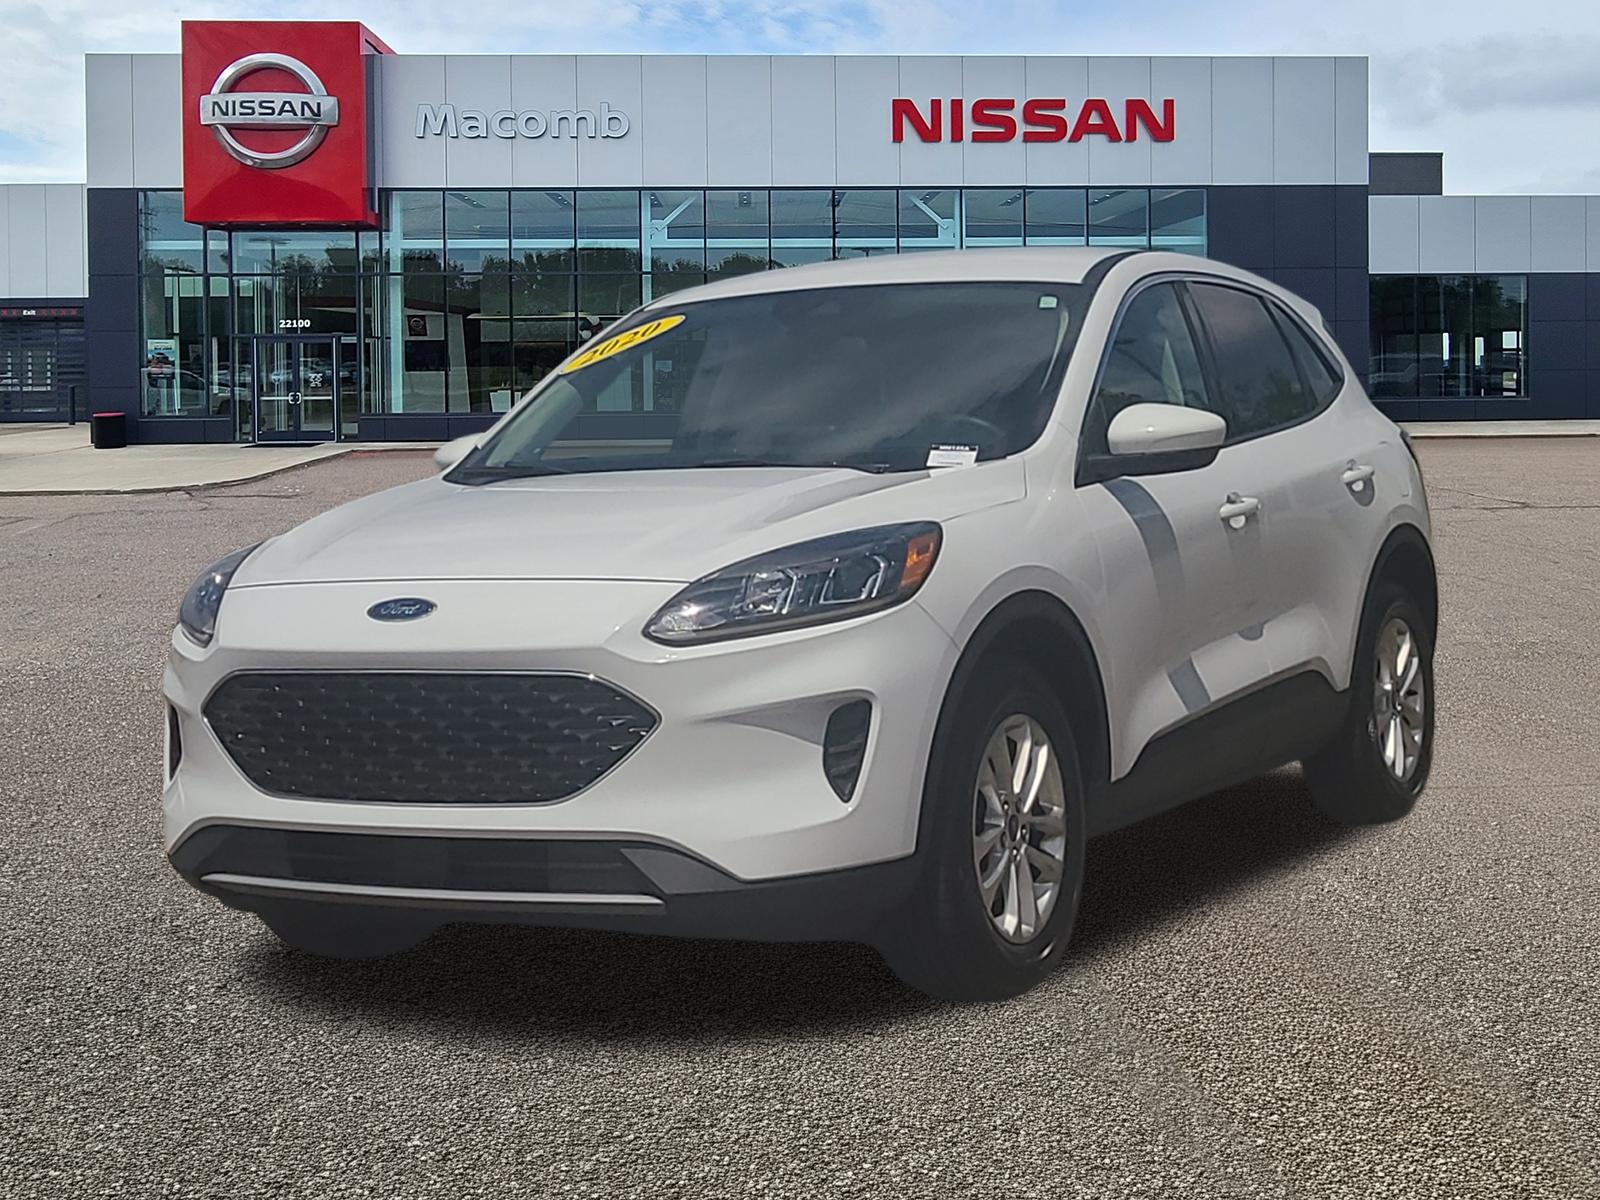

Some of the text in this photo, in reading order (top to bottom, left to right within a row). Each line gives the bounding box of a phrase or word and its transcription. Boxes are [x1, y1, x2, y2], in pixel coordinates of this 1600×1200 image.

[212, 100, 322, 117] NISSAN
[415, 101, 630, 138] Macomb
[892, 98, 1175, 142] NISSAN
[279, 319, 311, 328] 22100
[579, 322, 662, 366] 2020
[380, 602, 420, 615] Ford
